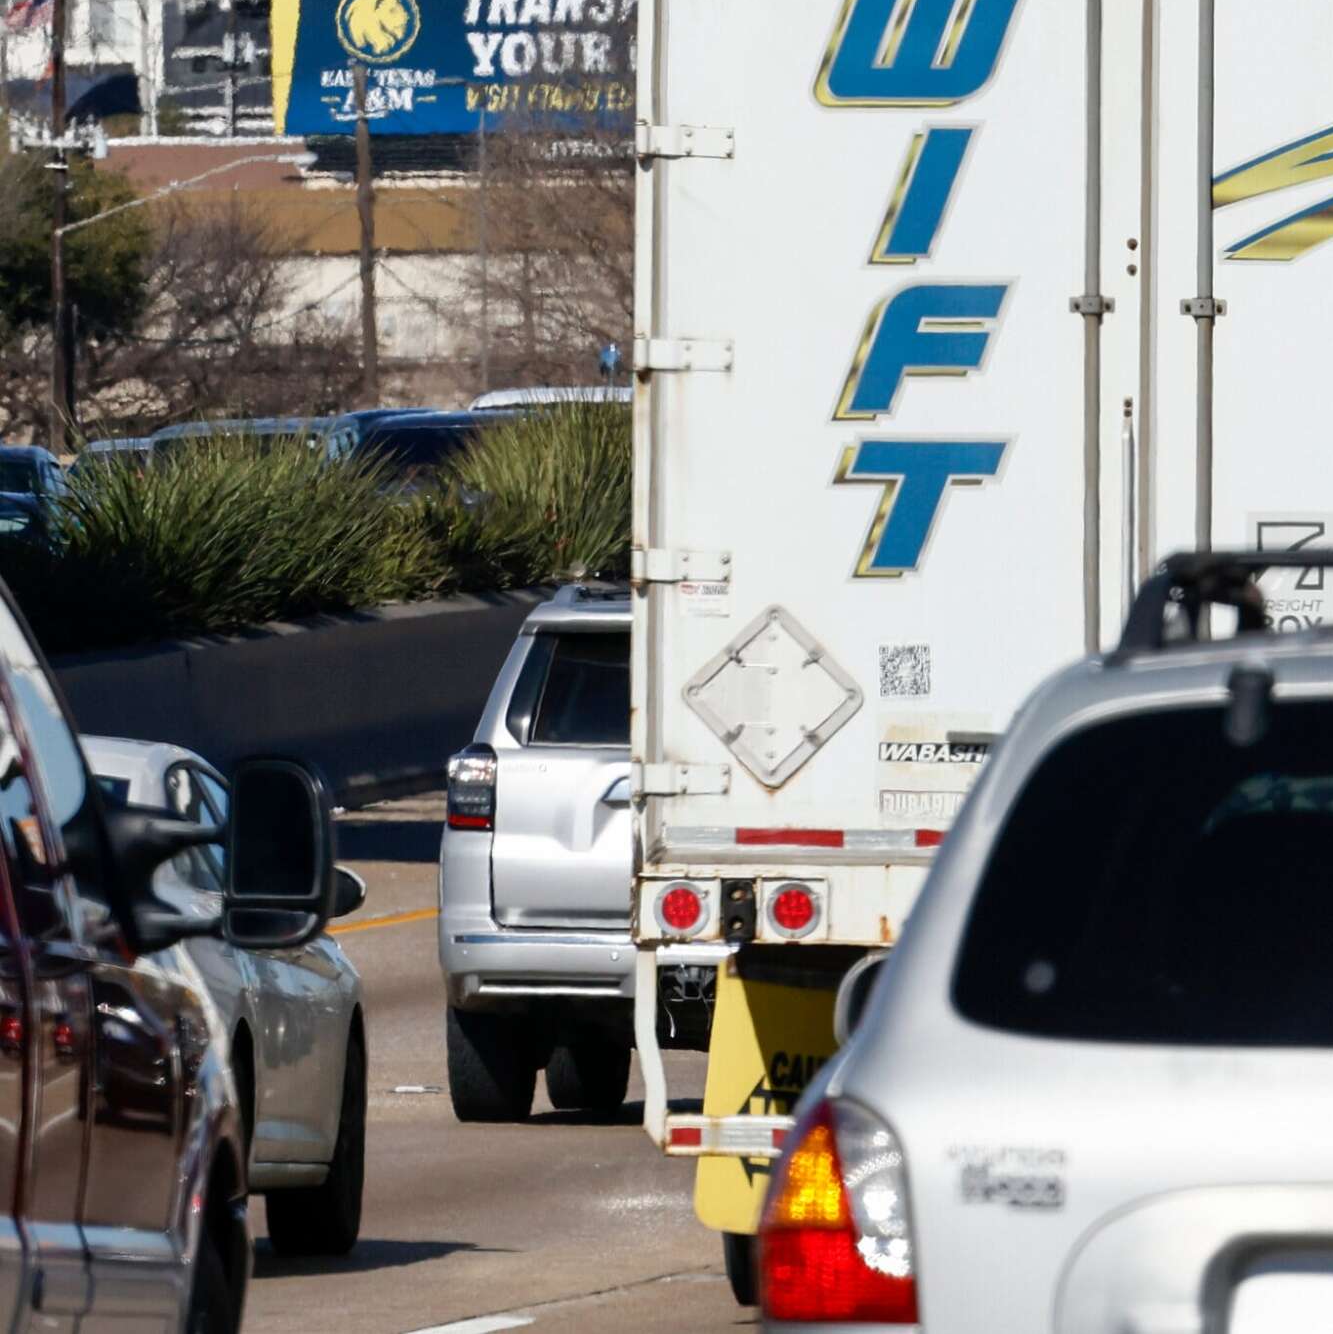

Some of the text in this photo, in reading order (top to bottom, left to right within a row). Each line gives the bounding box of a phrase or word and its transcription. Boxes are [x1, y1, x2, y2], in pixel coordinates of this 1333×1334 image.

[466, 30, 612, 77] YOUR
[321, 68, 437, 87] EAS TEXAS
[1263, 599, 1324, 612] REIGHT
